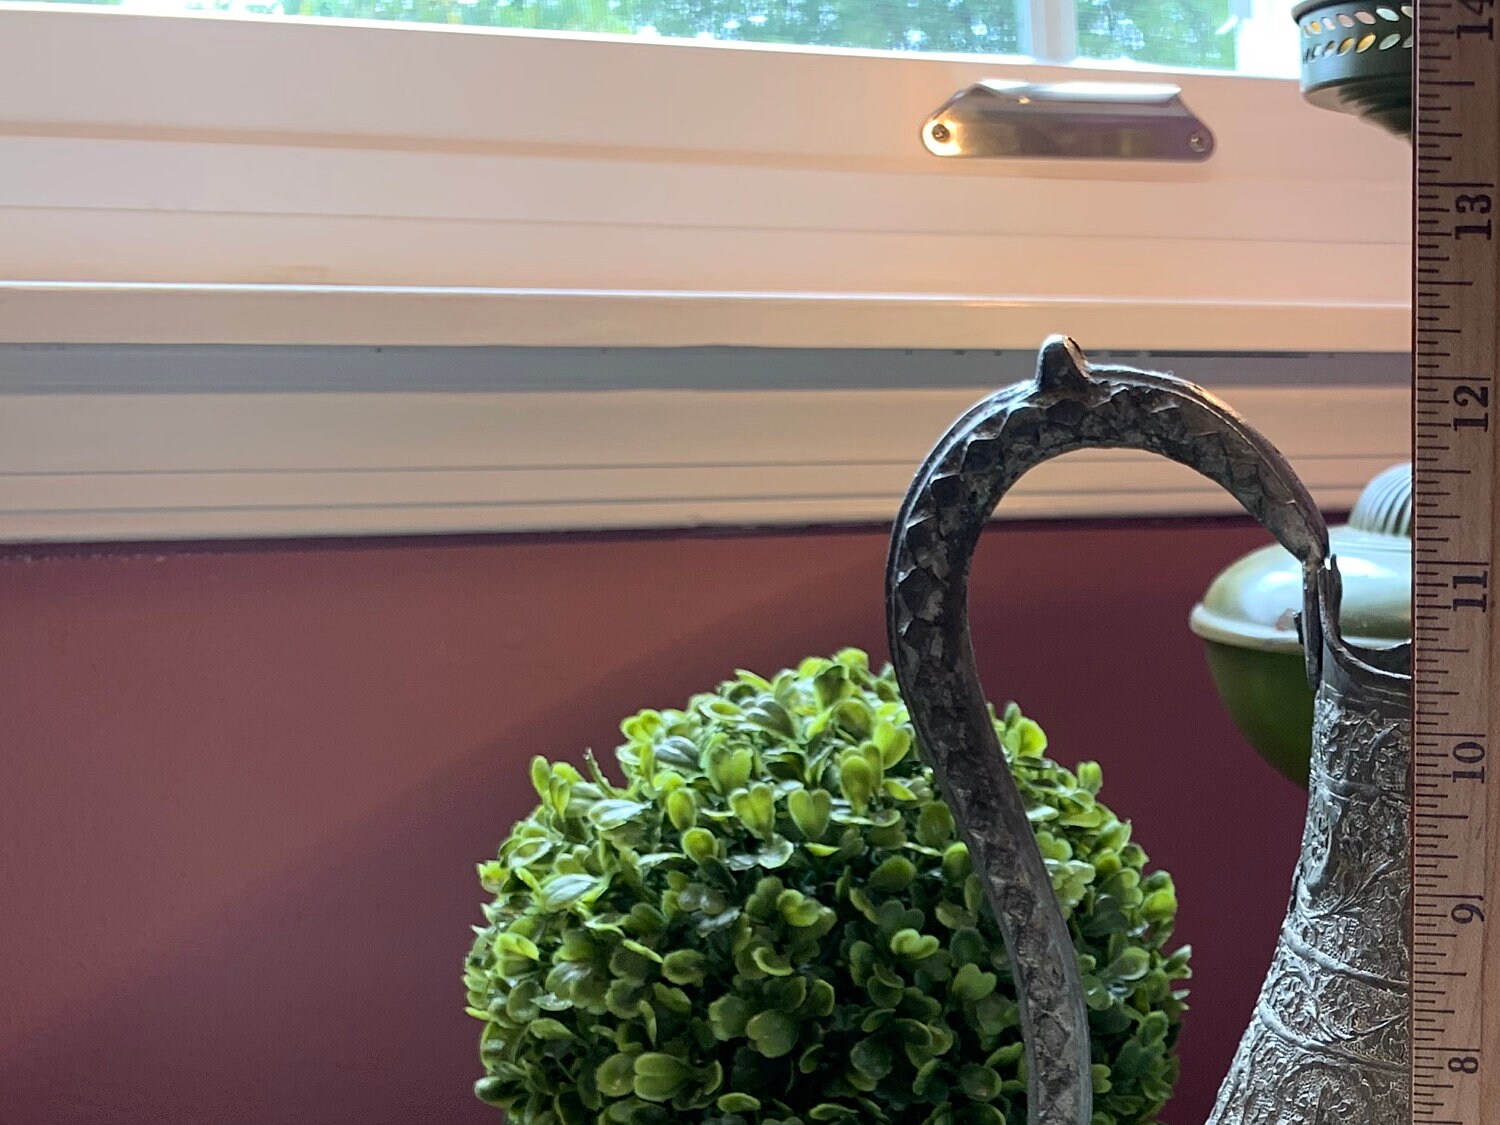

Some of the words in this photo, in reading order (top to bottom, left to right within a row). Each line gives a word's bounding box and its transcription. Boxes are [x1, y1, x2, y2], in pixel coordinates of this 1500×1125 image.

[1454, 193, 1493, 241] 13
[1453, 385, 1489, 432] 12
[1452, 570, 1488, 613] 11
[1452, 740, 1486, 784] 10
[1450, 902, 1485, 925] 9
[1447, 1055, 1479, 1075] 8
